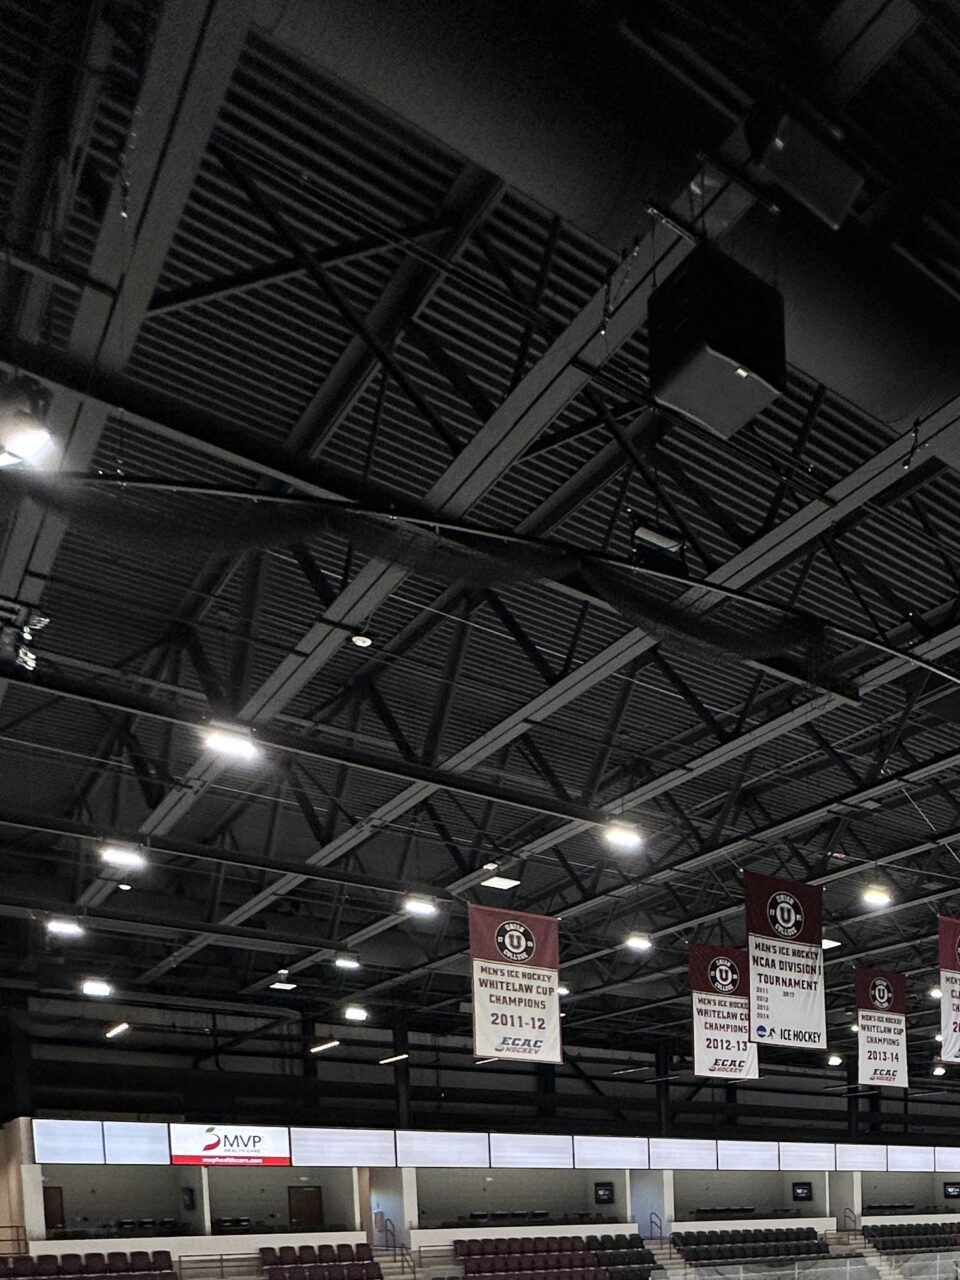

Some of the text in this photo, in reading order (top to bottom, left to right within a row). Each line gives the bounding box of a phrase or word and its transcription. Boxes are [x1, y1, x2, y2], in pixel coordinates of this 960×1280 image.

[508, 934, 522, 950] U
[755, 942, 819, 961] MEN'S ICE HOCKEY
[752, 955, 777, 969] NCAA
[779, 960, 817, 975] DIVISION
[480, 966, 552, 983] MEN'S ICE HOCKEY
[757, 973, 818, 991] TOURNAMENT
[479, 977, 555, 997] WHITELAW CUP
[489, 994, 546, 1010] CHAMPIONS
[698, 997, 749, 1010] MEN'S ICE HOCKE
[491, 1013, 546, 1030] 2011-12
[696, 1008, 749, 1022] WHITELAW CU
[704, 1022, 748, 1034] CHAMPIONS
[860, 1024, 904, 1036] WHITELAW CUP
[501, 1036, 543, 1049] ECAC
[780, 1028, 821, 1044] ICE HOCKEY
[866, 1036, 900, 1047] CHAMPIONS
[505, 1046, 540, 1055] HOCKEY
[706, 1037, 748, 1052] 2012-13
[714, 1058, 746, 1068] ECAC
[867, 1050, 899, 1063] 2013-14
[873, 1068, 898, 1077] ECAC
[223, 1134, 262, 1149] MVP
